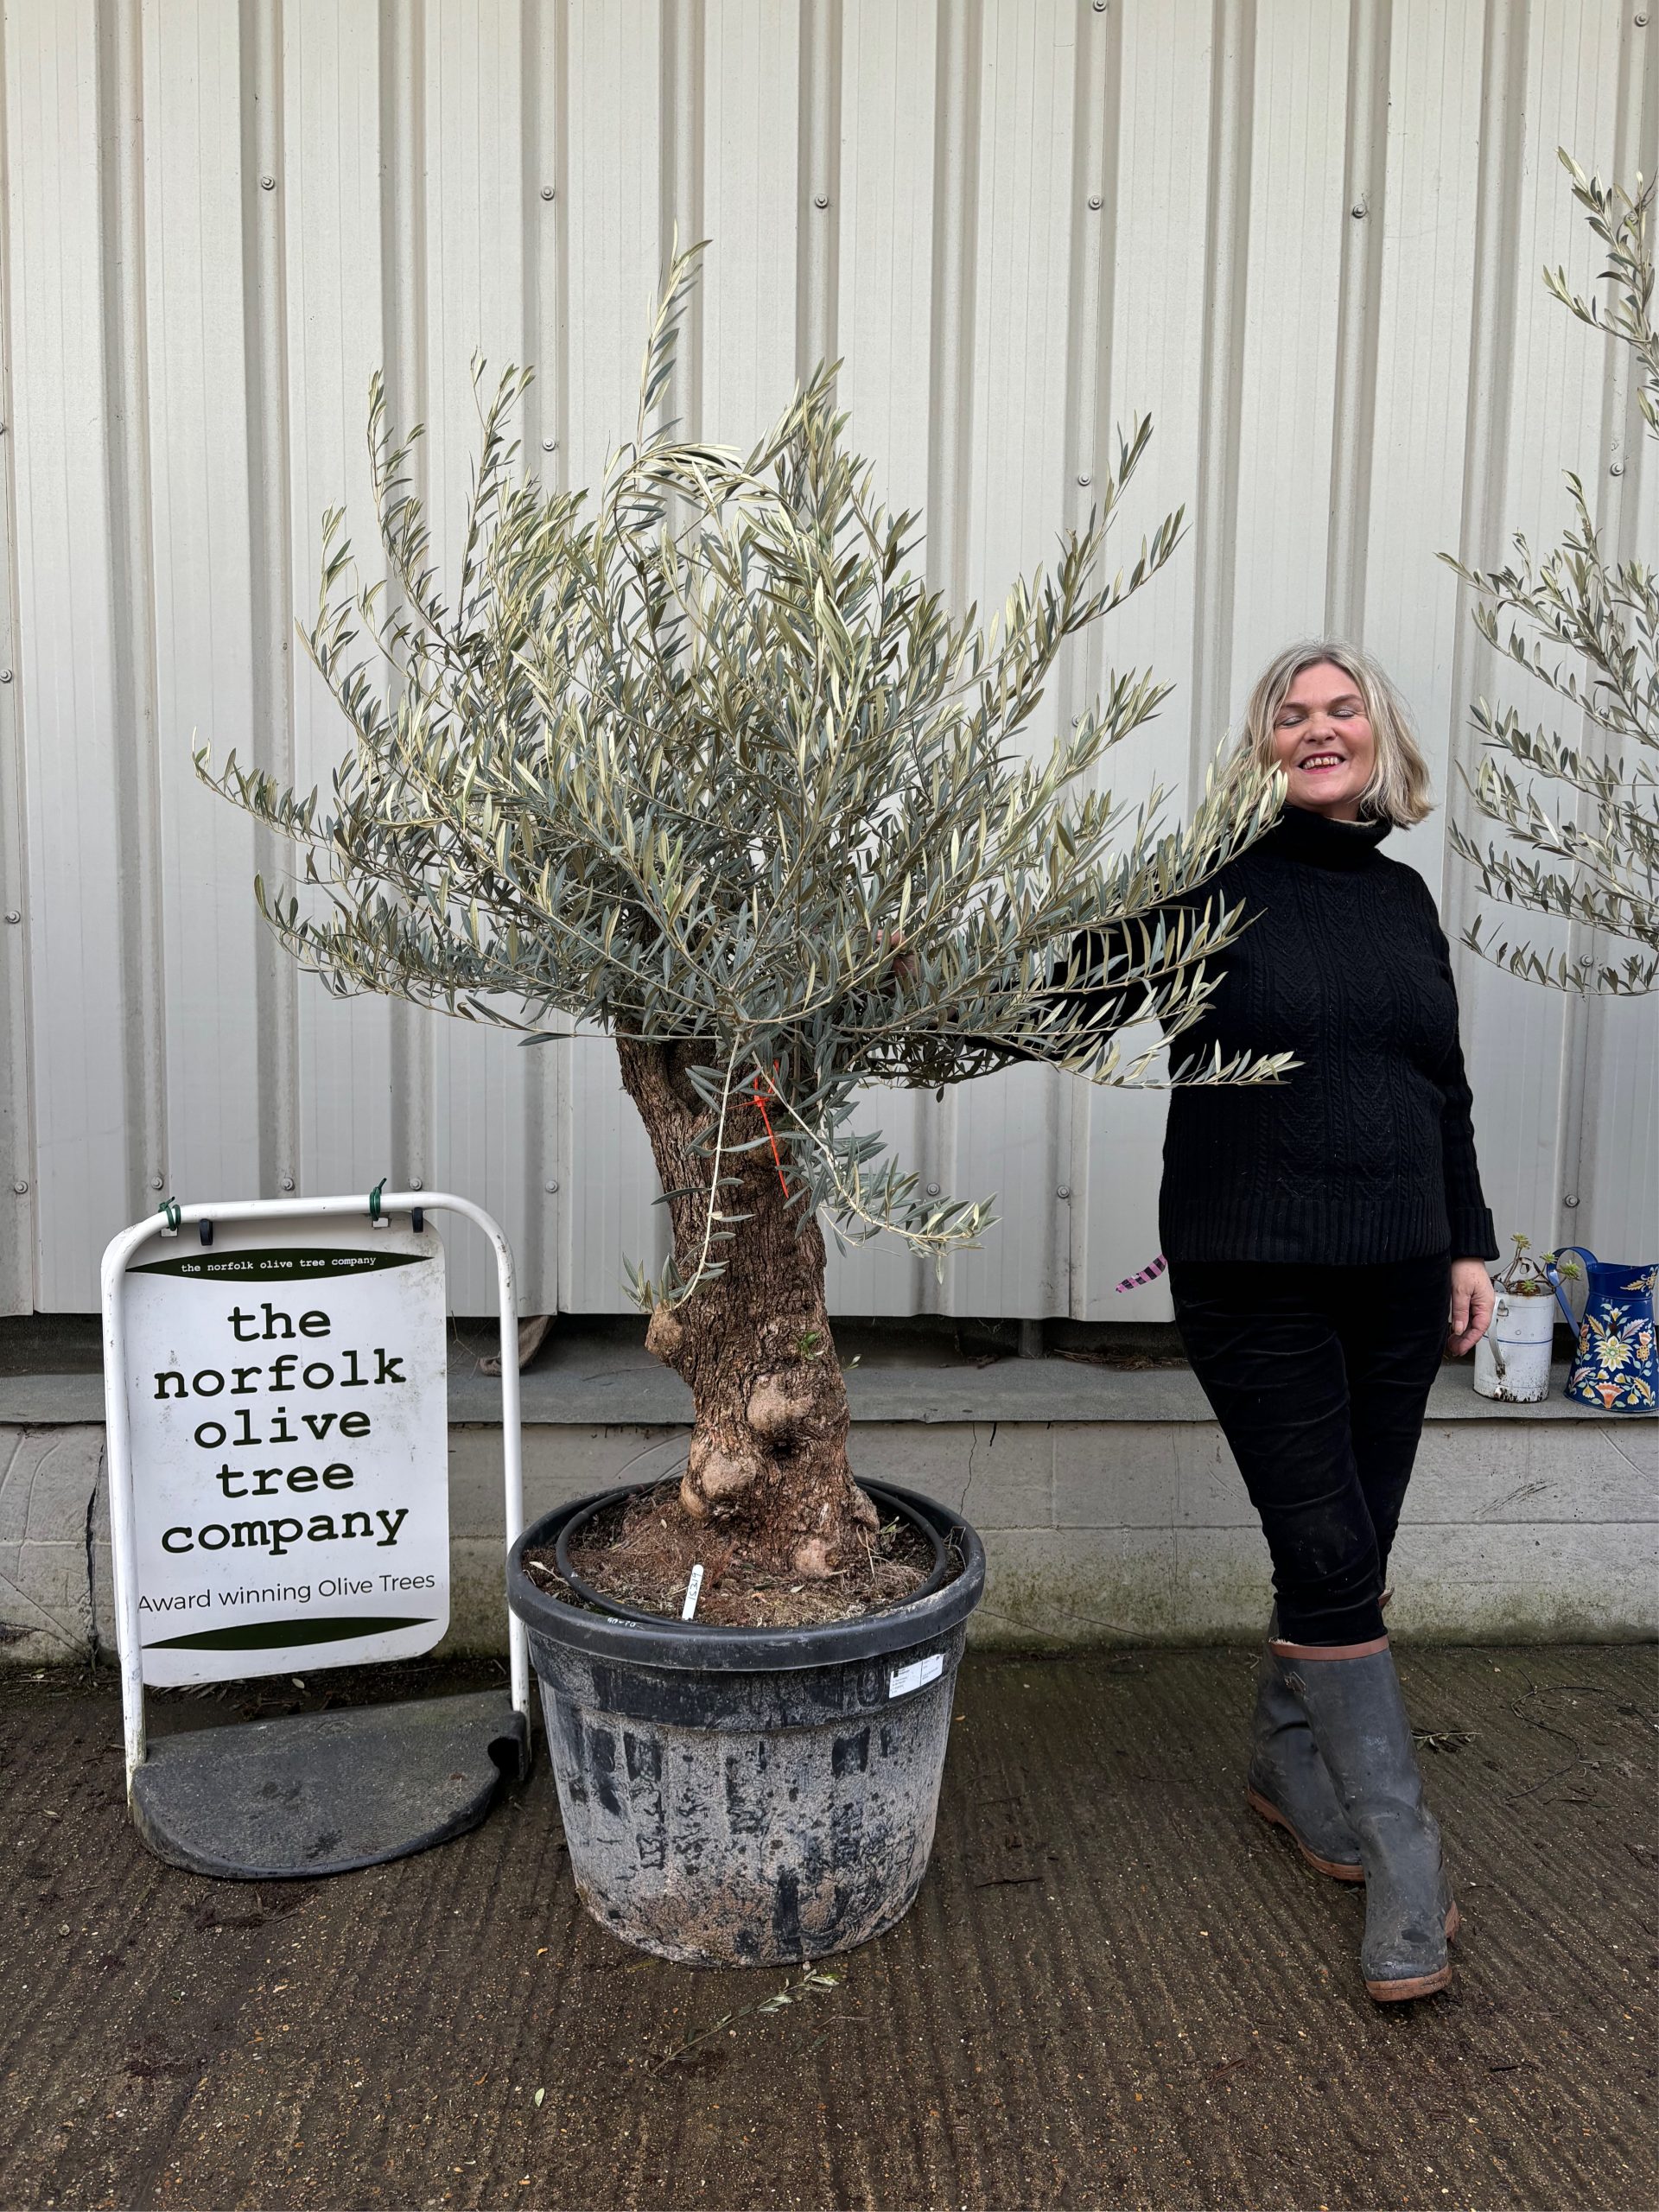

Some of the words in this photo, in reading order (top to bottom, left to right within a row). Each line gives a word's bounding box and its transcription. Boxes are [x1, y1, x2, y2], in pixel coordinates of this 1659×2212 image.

[181, 1262, 201, 1273] the
[207, 1260, 254, 1271] norfolk
[259, 1258, 293, 1269] olive
[299, 1258, 326, 1268] tree
[331, 1255, 377, 1268] company
[227, 1303, 331, 1342] the
[154, 1348, 407, 1400] norfolk
[194, 1406, 371, 1449] olive
[216, 1463, 354, 1498] tree
[162, 1508, 410, 1555] company
[138, 1589, 211, 1612] Award
[218, 1583, 311, 1605] winning
[318, 1577, 373, 1599] Olive
[378, 1573, 435, 1592] Trees
